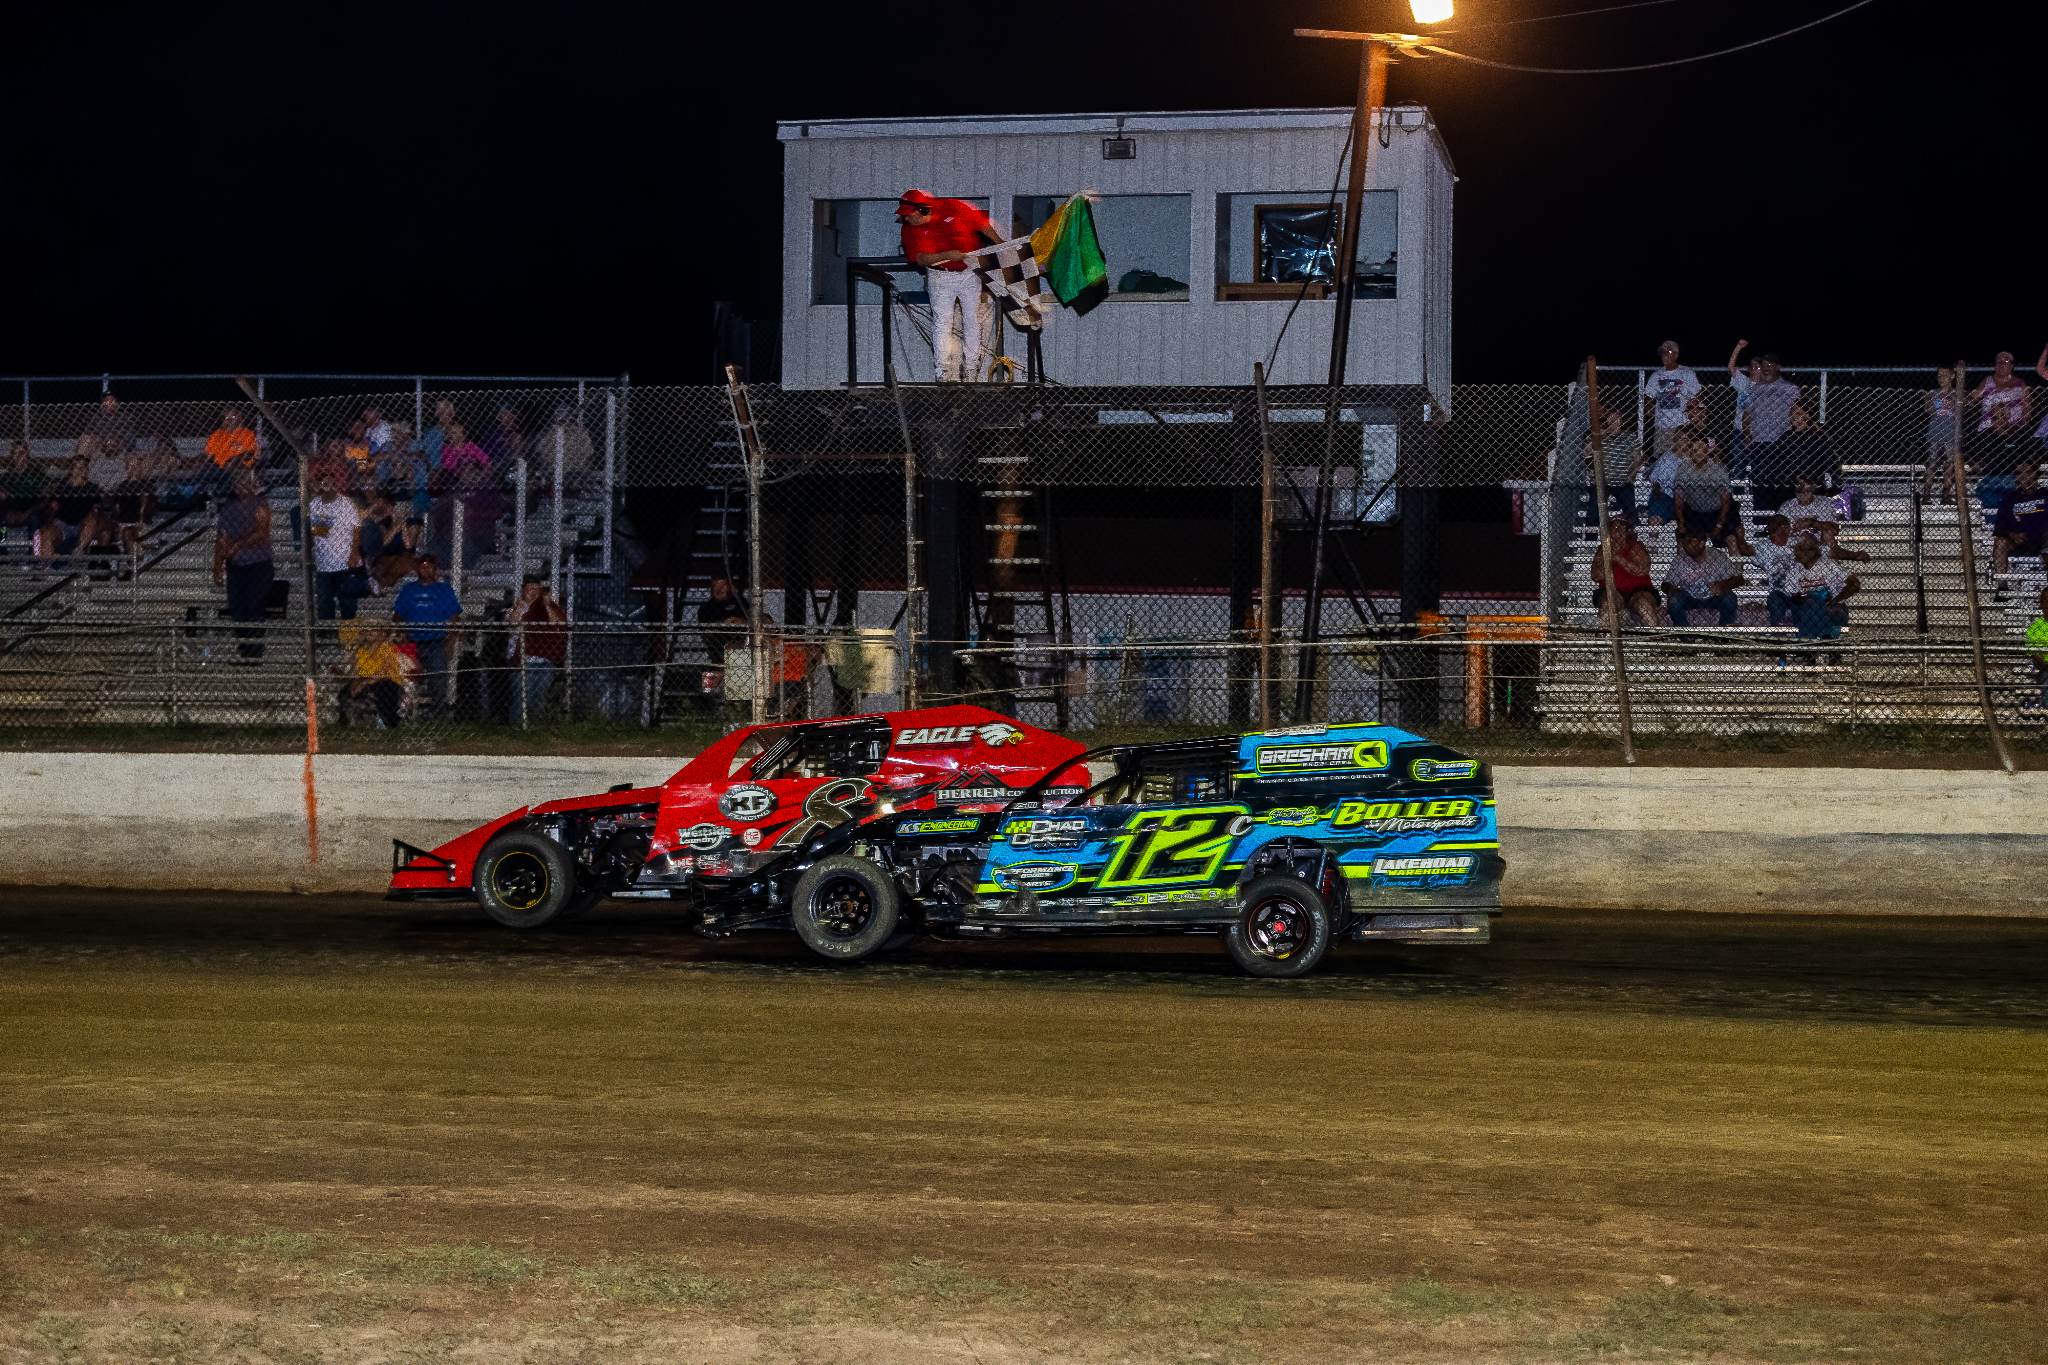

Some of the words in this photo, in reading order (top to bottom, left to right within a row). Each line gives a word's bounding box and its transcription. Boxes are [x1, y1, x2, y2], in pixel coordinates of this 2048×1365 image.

[896, 726, 976, 745] EAGLE
[1260, 747, 1354, 764] GRESHAM
[938, 788, 1006, 800] HERREN
[1007, 789, 1083, 797] COUCTION
[731, 796, 767, 811] KF
[920, 820, 978, 832] ENGINEERING
[1032, 820, 1085, 833] CHAD
[1377, 815, 1478, 832] Motorsports
[1374, 857, 1472, 873] LAKEROAD
[1387, 867, 1469, 876] WAREHOUSE
